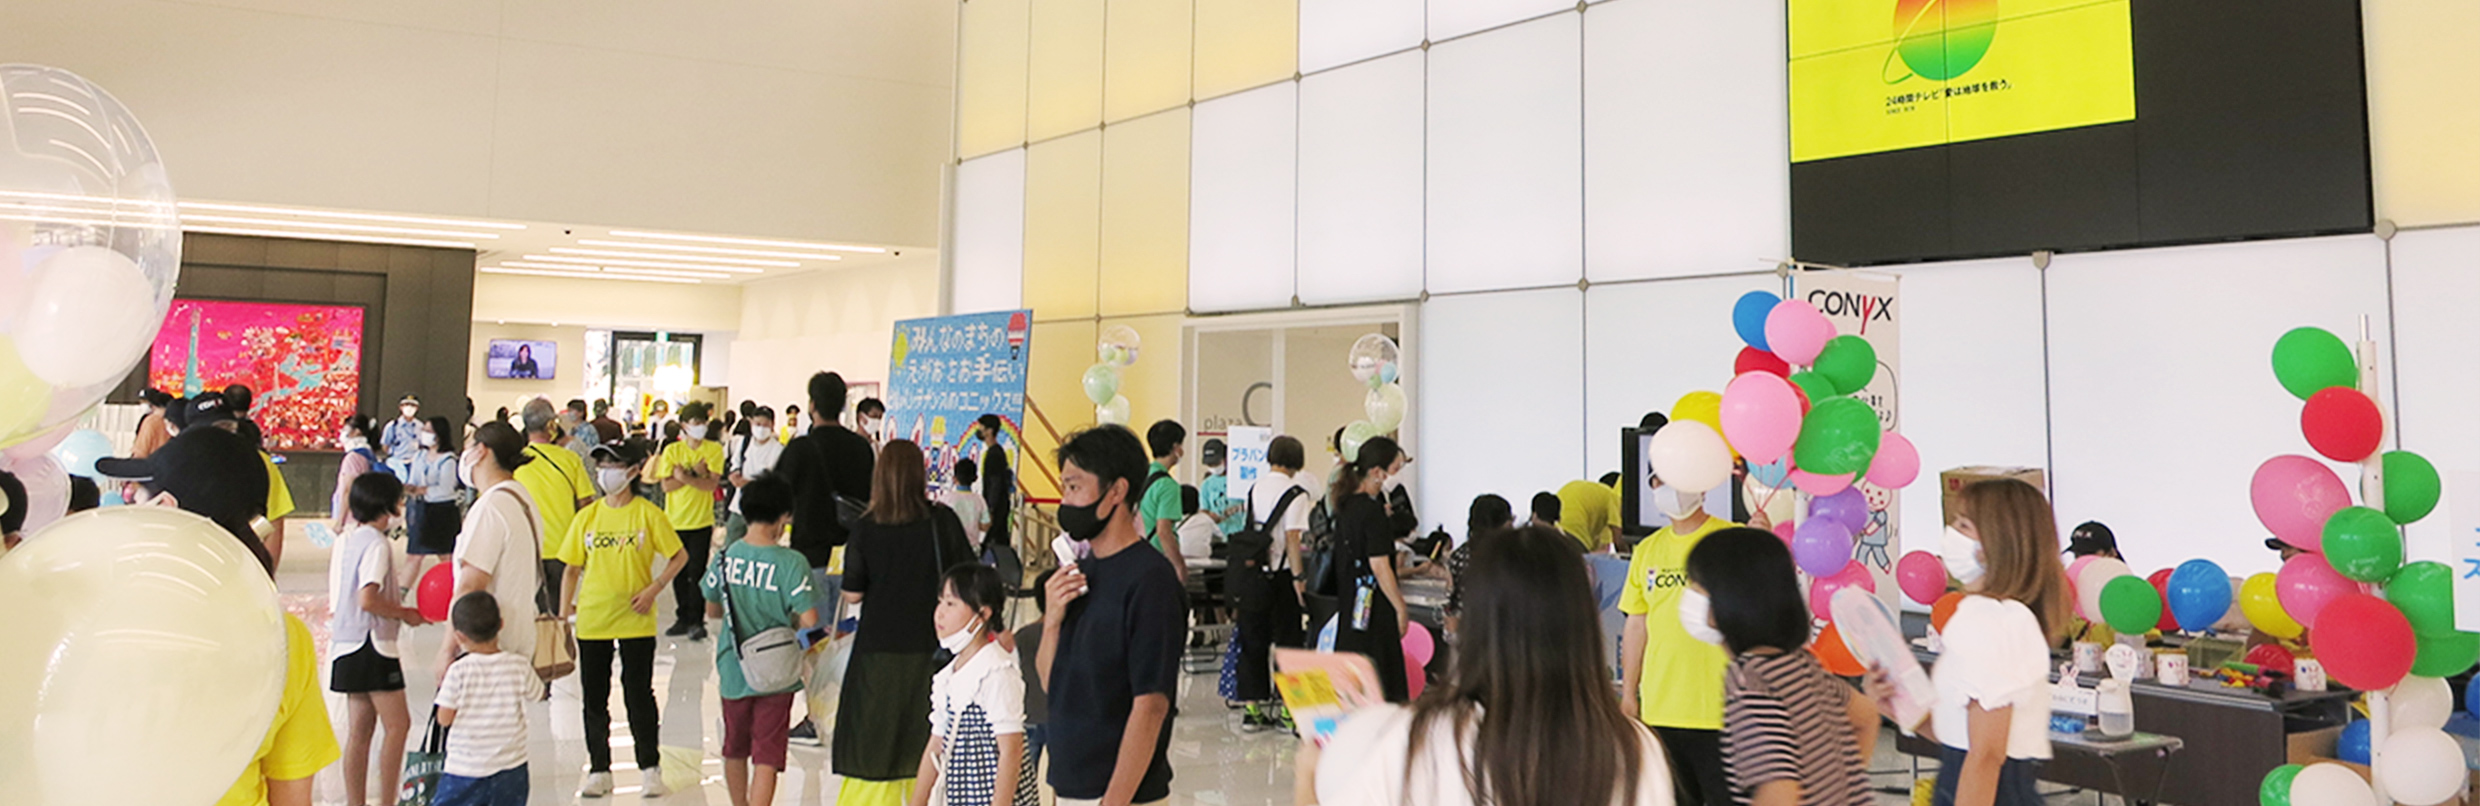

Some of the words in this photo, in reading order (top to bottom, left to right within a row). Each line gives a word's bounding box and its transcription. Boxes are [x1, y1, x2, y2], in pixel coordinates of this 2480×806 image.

[910, 322, 1006, 353] みんなのまちの
